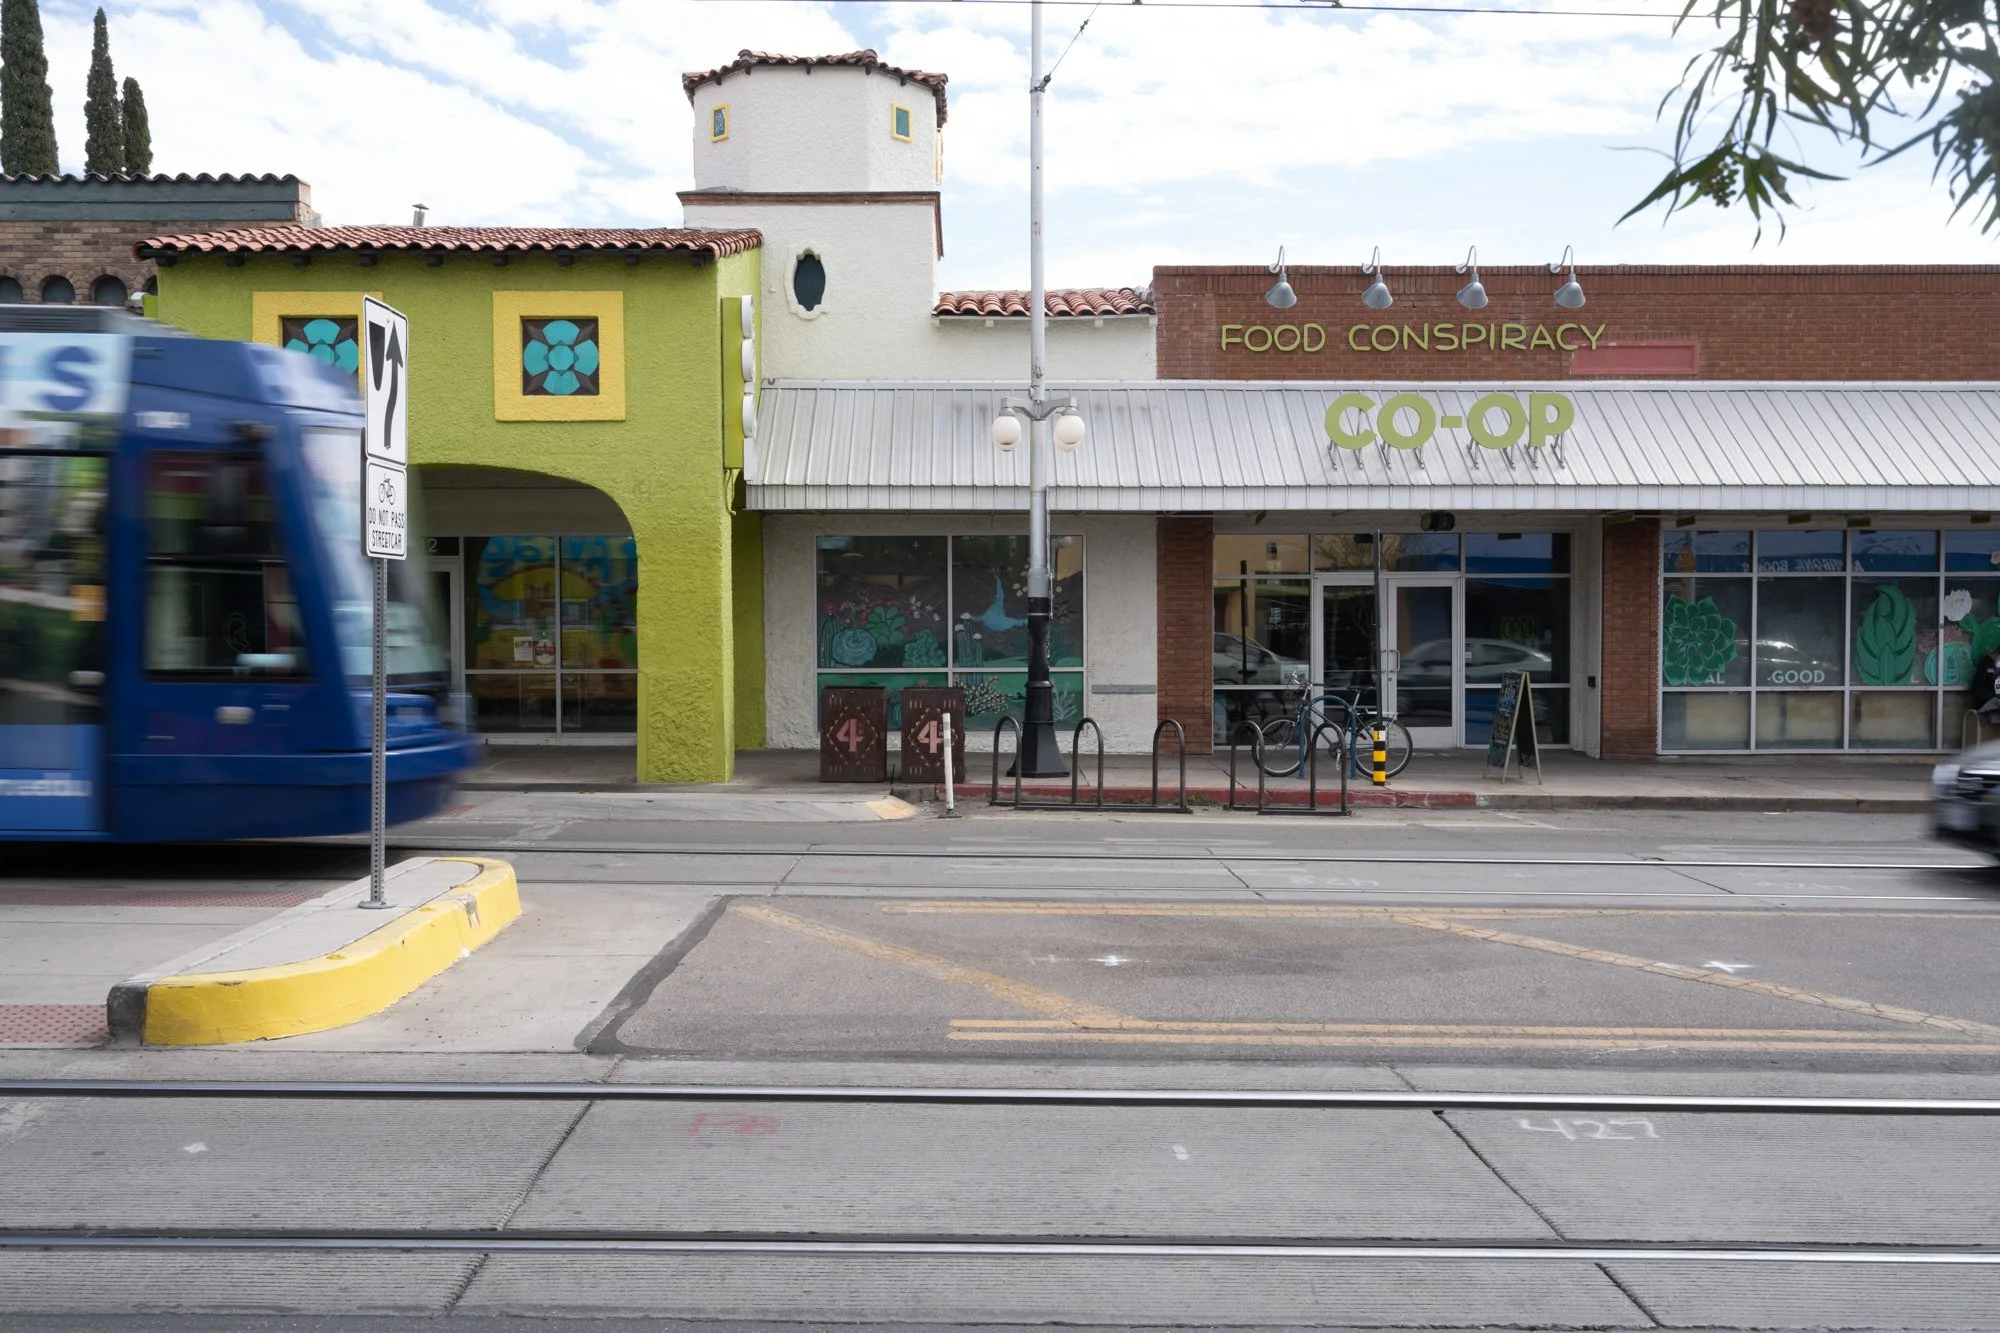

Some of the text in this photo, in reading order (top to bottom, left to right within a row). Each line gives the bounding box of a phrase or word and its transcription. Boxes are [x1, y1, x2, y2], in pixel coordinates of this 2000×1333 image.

[1221, 323, 1606, 352] FOOD CONSPIRACY
[1324, 392, 1574, 450] CO-OP
[368, 507, 404, 529] DO NOT PASS
[372, 529, 401, 549] STREETCAR
[1502, 617, 1538, 640] OPEN
[1772, 670, 1825, 684] GOOD
